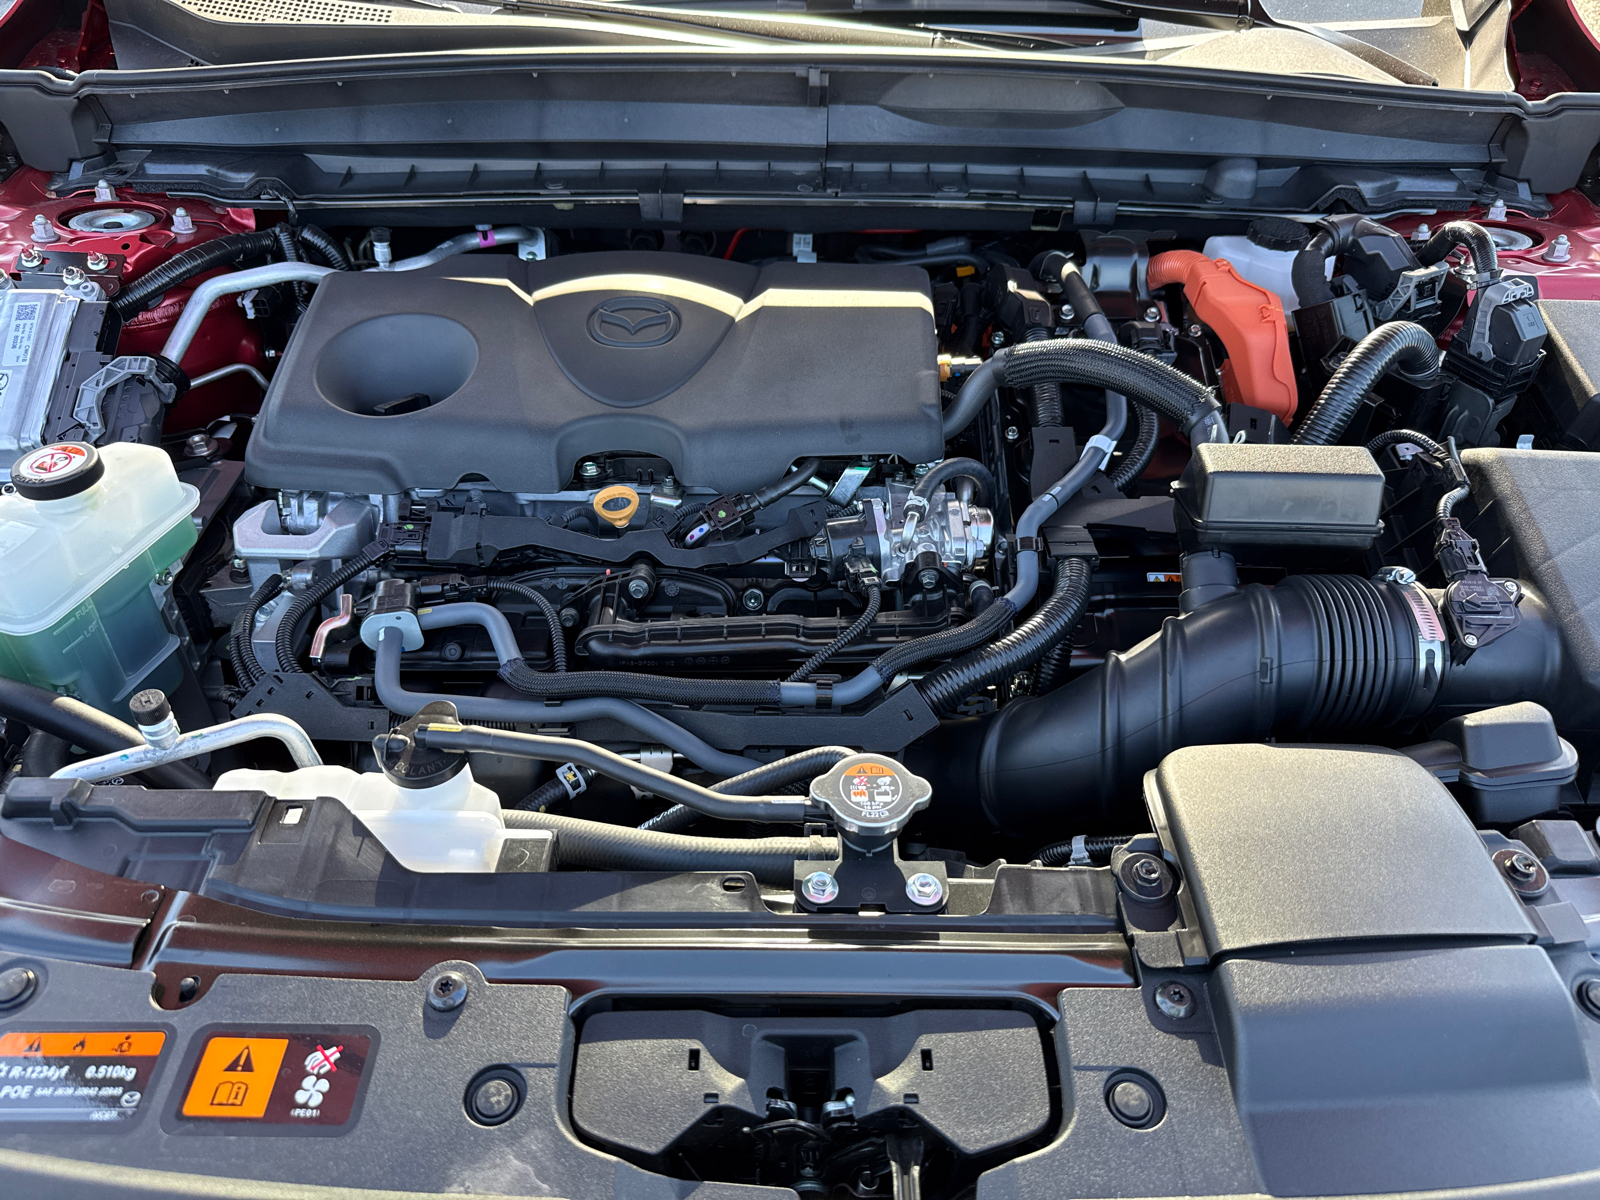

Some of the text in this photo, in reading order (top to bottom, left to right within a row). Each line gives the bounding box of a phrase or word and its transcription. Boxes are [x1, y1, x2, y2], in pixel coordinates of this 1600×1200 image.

[8, 1065, 137, 1082] R-1234yf 0.510kg
[0, 1085, 33, 1099] POE
[290, 1108, 320, 1118] (PE01)
